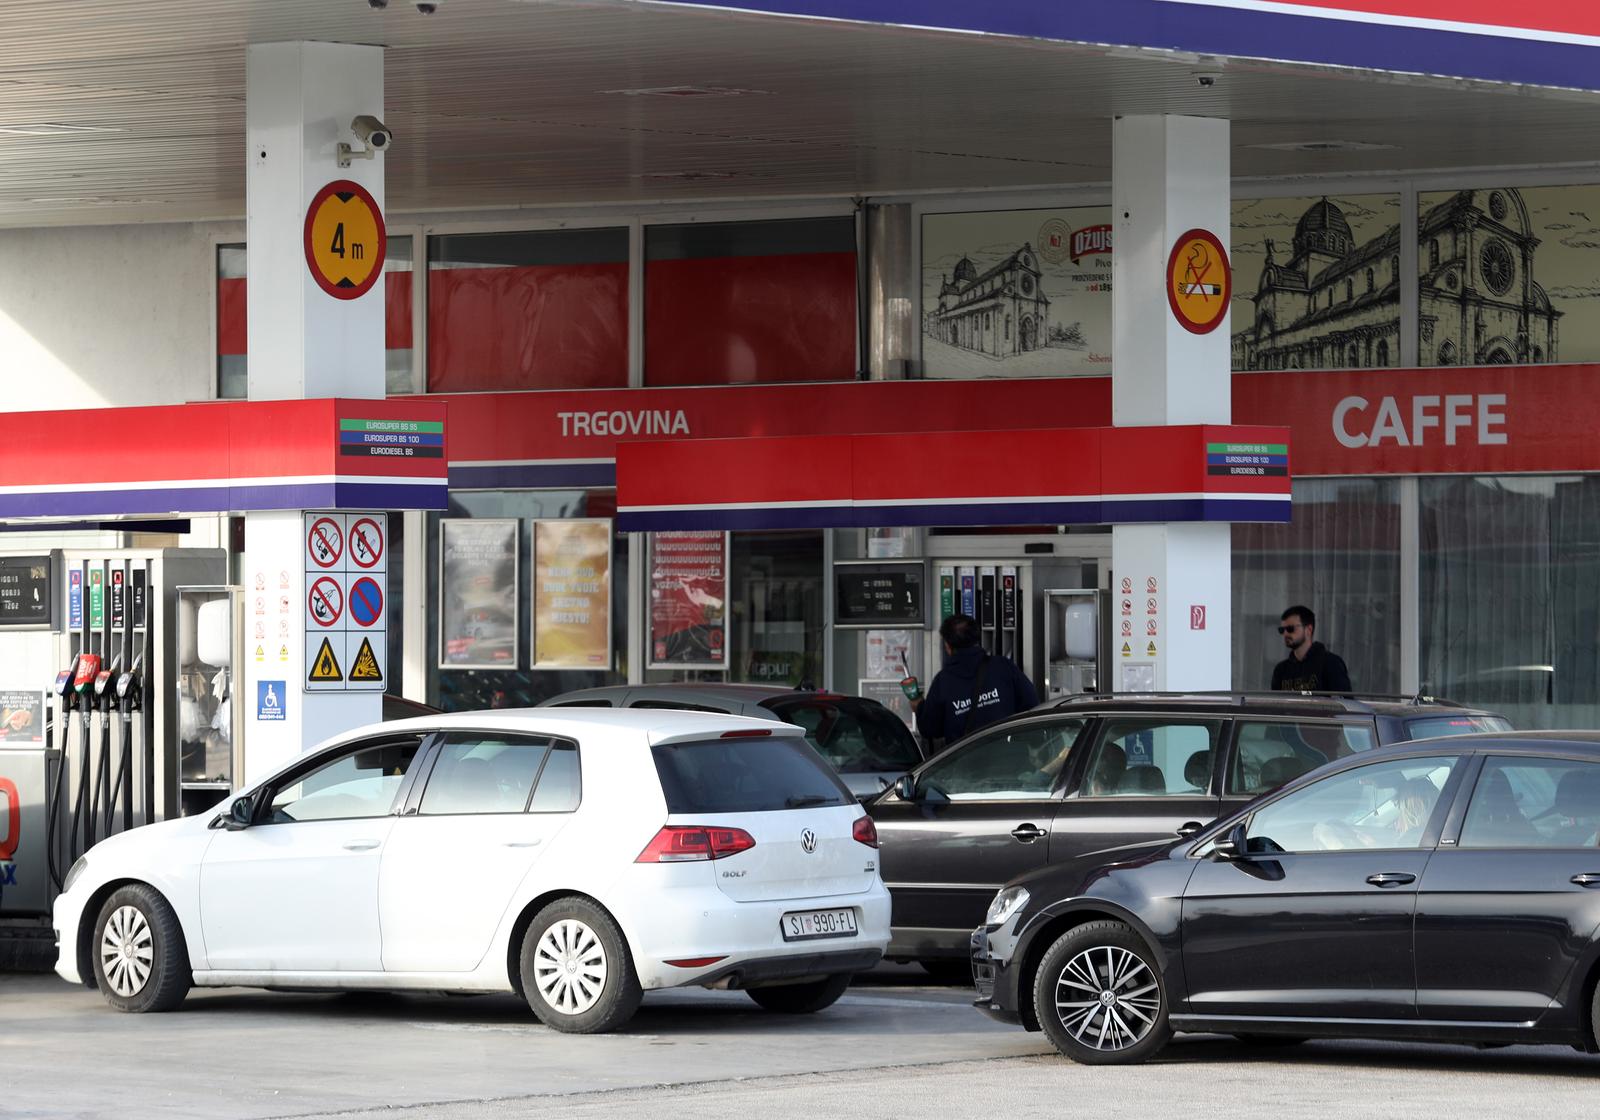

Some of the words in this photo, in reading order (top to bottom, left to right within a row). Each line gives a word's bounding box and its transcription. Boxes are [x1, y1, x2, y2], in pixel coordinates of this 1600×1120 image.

[331, 222, 345, 259] 4
[352, 243, 364, 260] m
[366, 421, 400, 430] EUROSUPER
[557, 409, 690, 437] TRGOVINA
[1331, 393, 1508, 449] CAFFE
[364, 434, 398, 443] EUROSUPER
[398, 435, 407, 444] BS
[408, 435, 420, 444] 100
[370, 446, 405, 455] EURODIESEL
[952, 698, 972, 710] Van
[722, 869, 747, 878] GOLF
[813, 912, 855, 932] 990-FL
